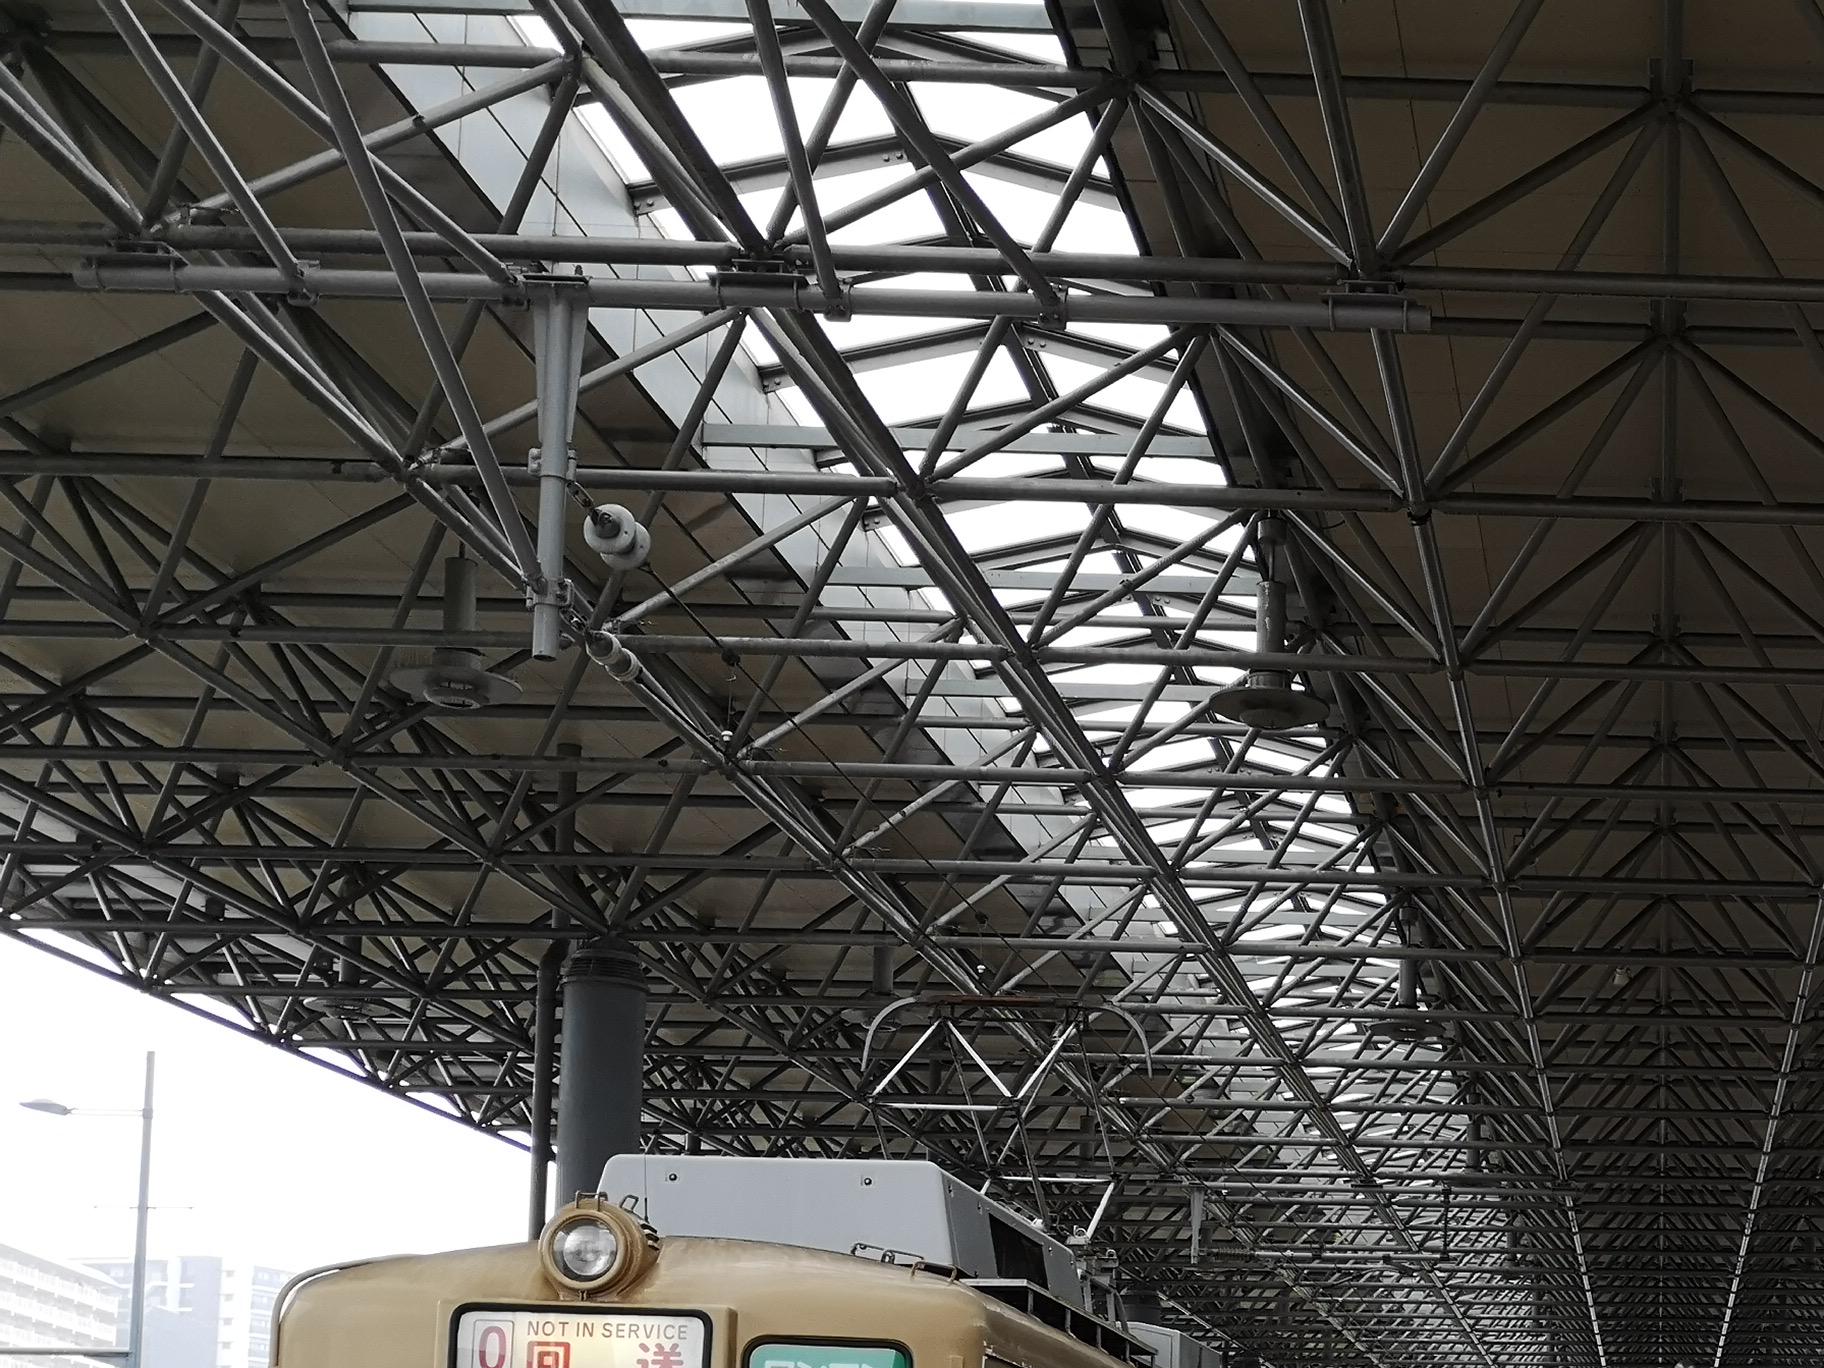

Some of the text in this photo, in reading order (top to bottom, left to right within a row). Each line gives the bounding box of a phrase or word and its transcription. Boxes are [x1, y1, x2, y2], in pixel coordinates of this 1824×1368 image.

[527, 1320, 689, 1341] NOT IN SERVICE
